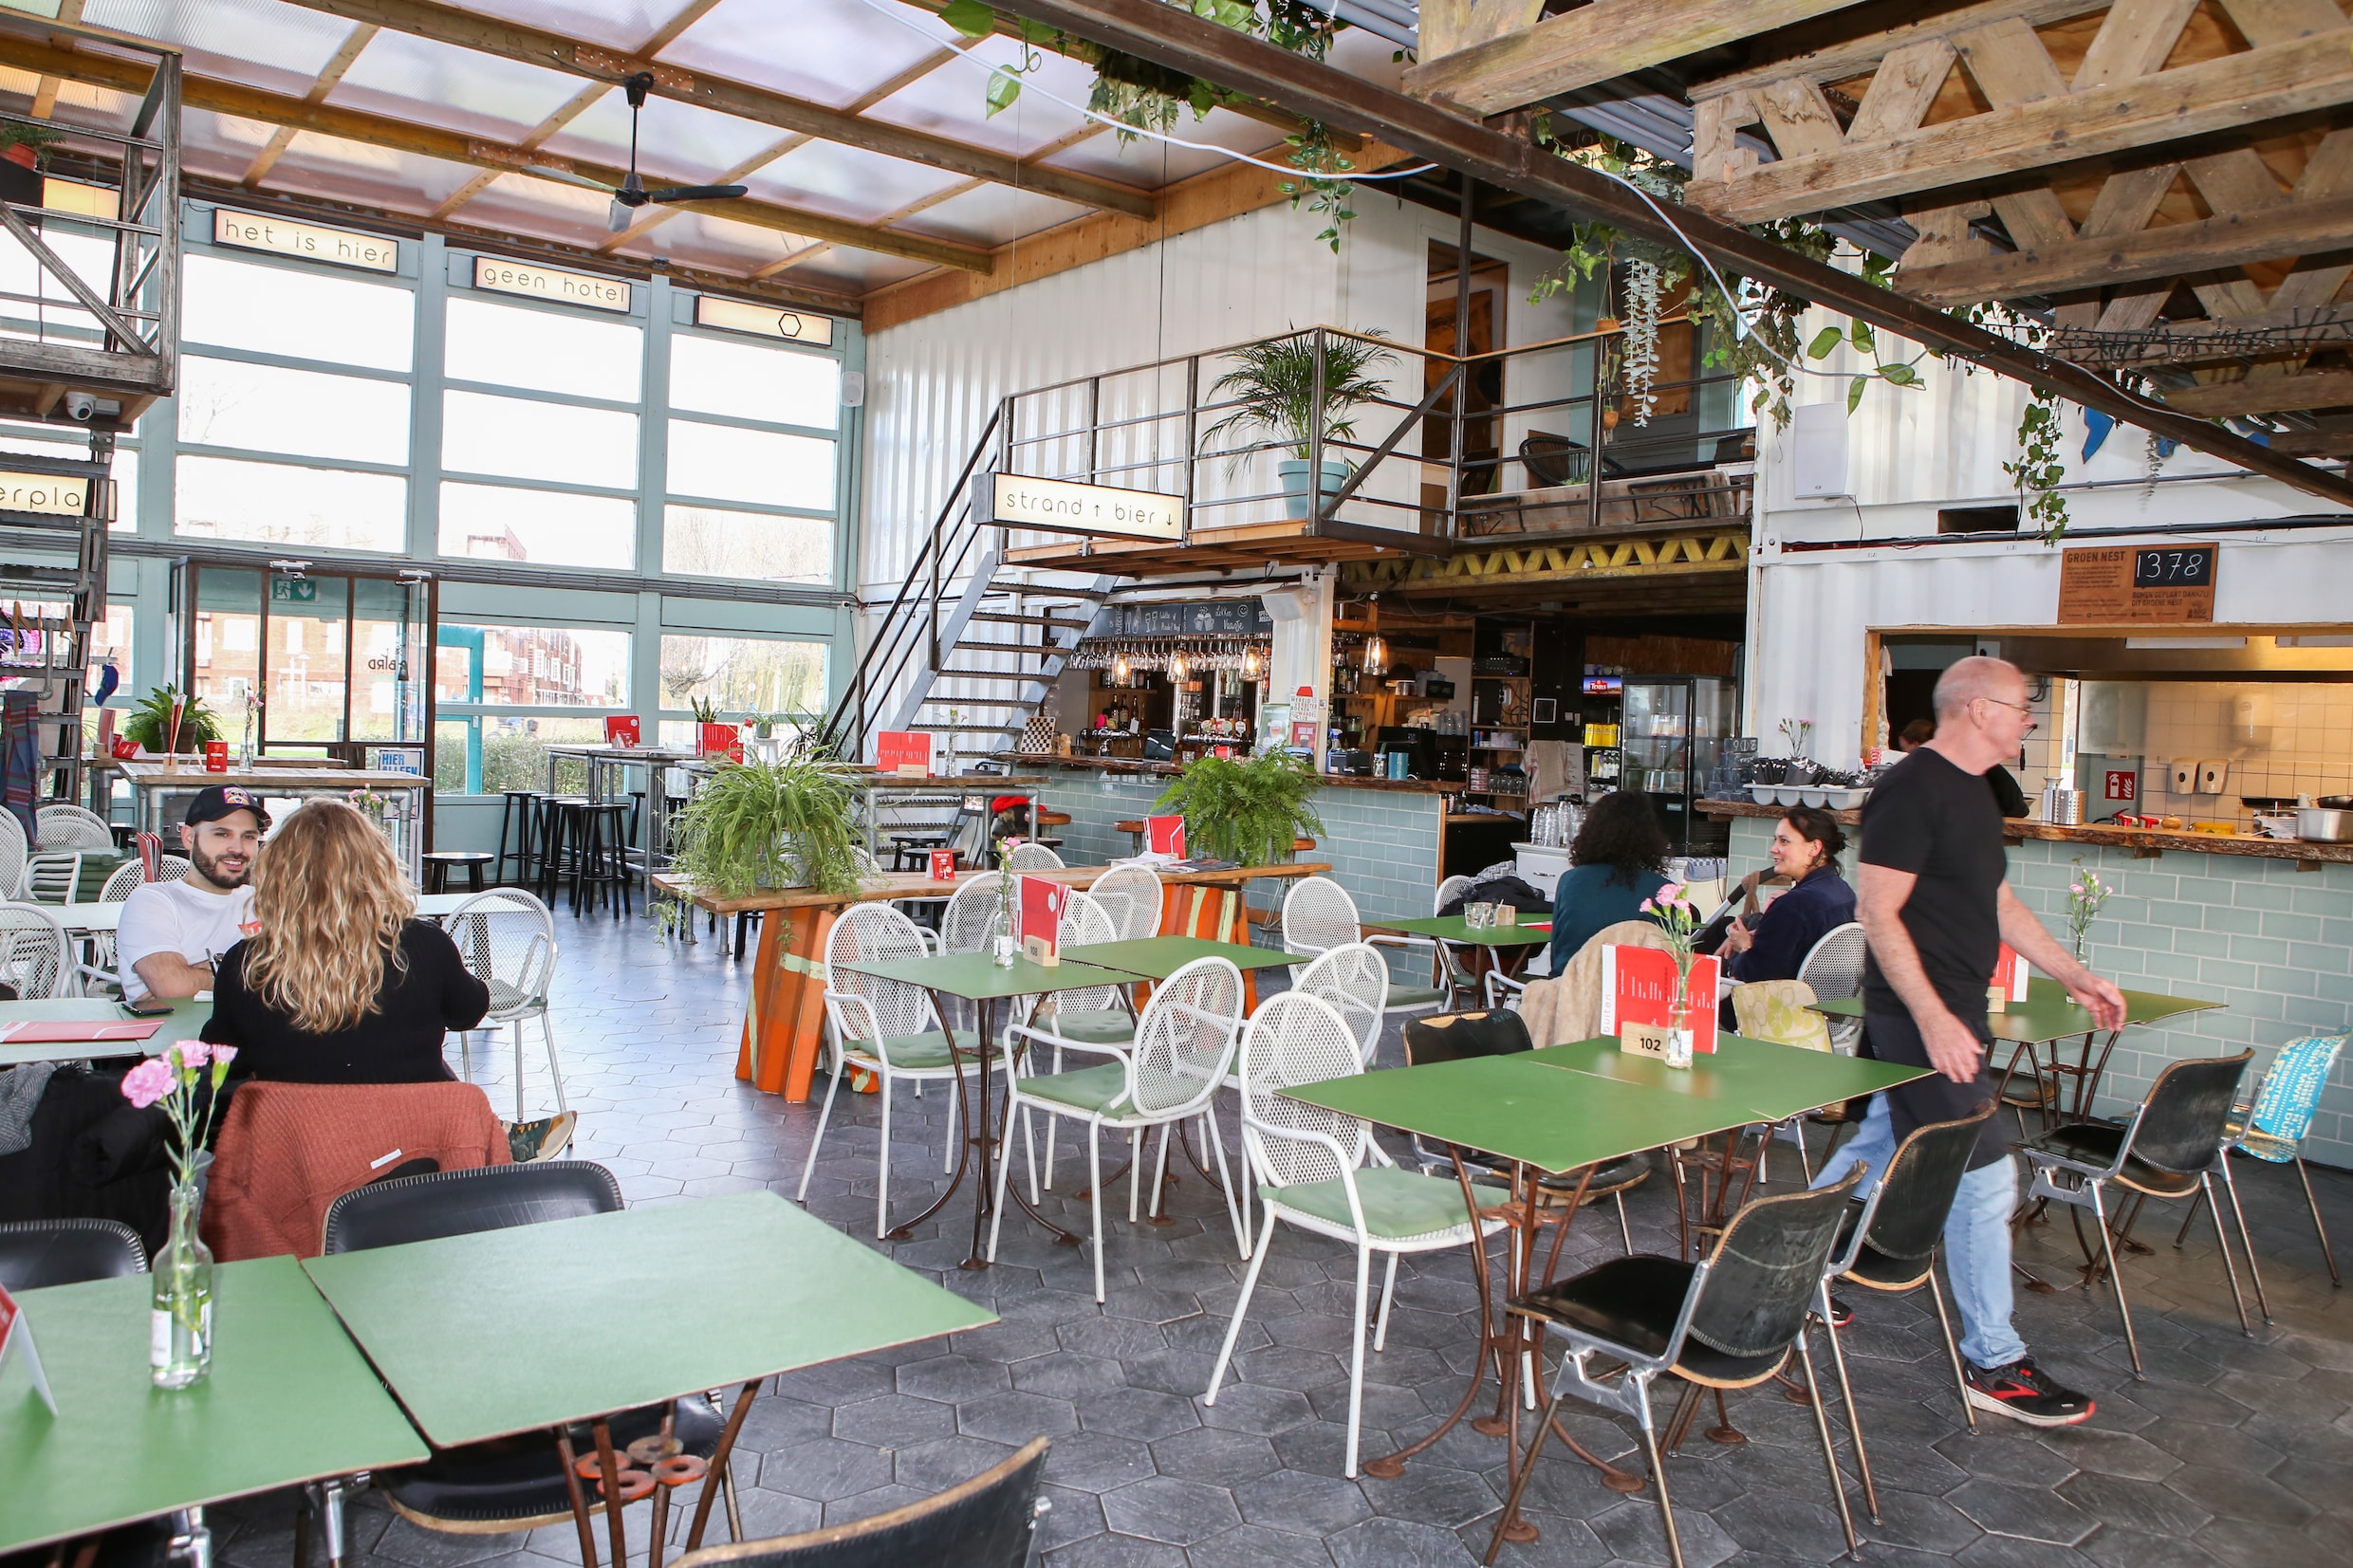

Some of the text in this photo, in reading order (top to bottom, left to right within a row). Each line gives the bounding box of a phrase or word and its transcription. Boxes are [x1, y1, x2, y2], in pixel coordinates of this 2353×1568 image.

[225, 218, 390, 264] het is hier
[484, 267, 624, 303] geen hotel
[1006, 490, 1156, 525] strand bier
[2066, 550, 2126, 563] GROEN NEST
[2136, 552, 2203, 580] 1378
[382, 753, 405, 766] HIER
[1640, 1037, 1661, 1052] 102
